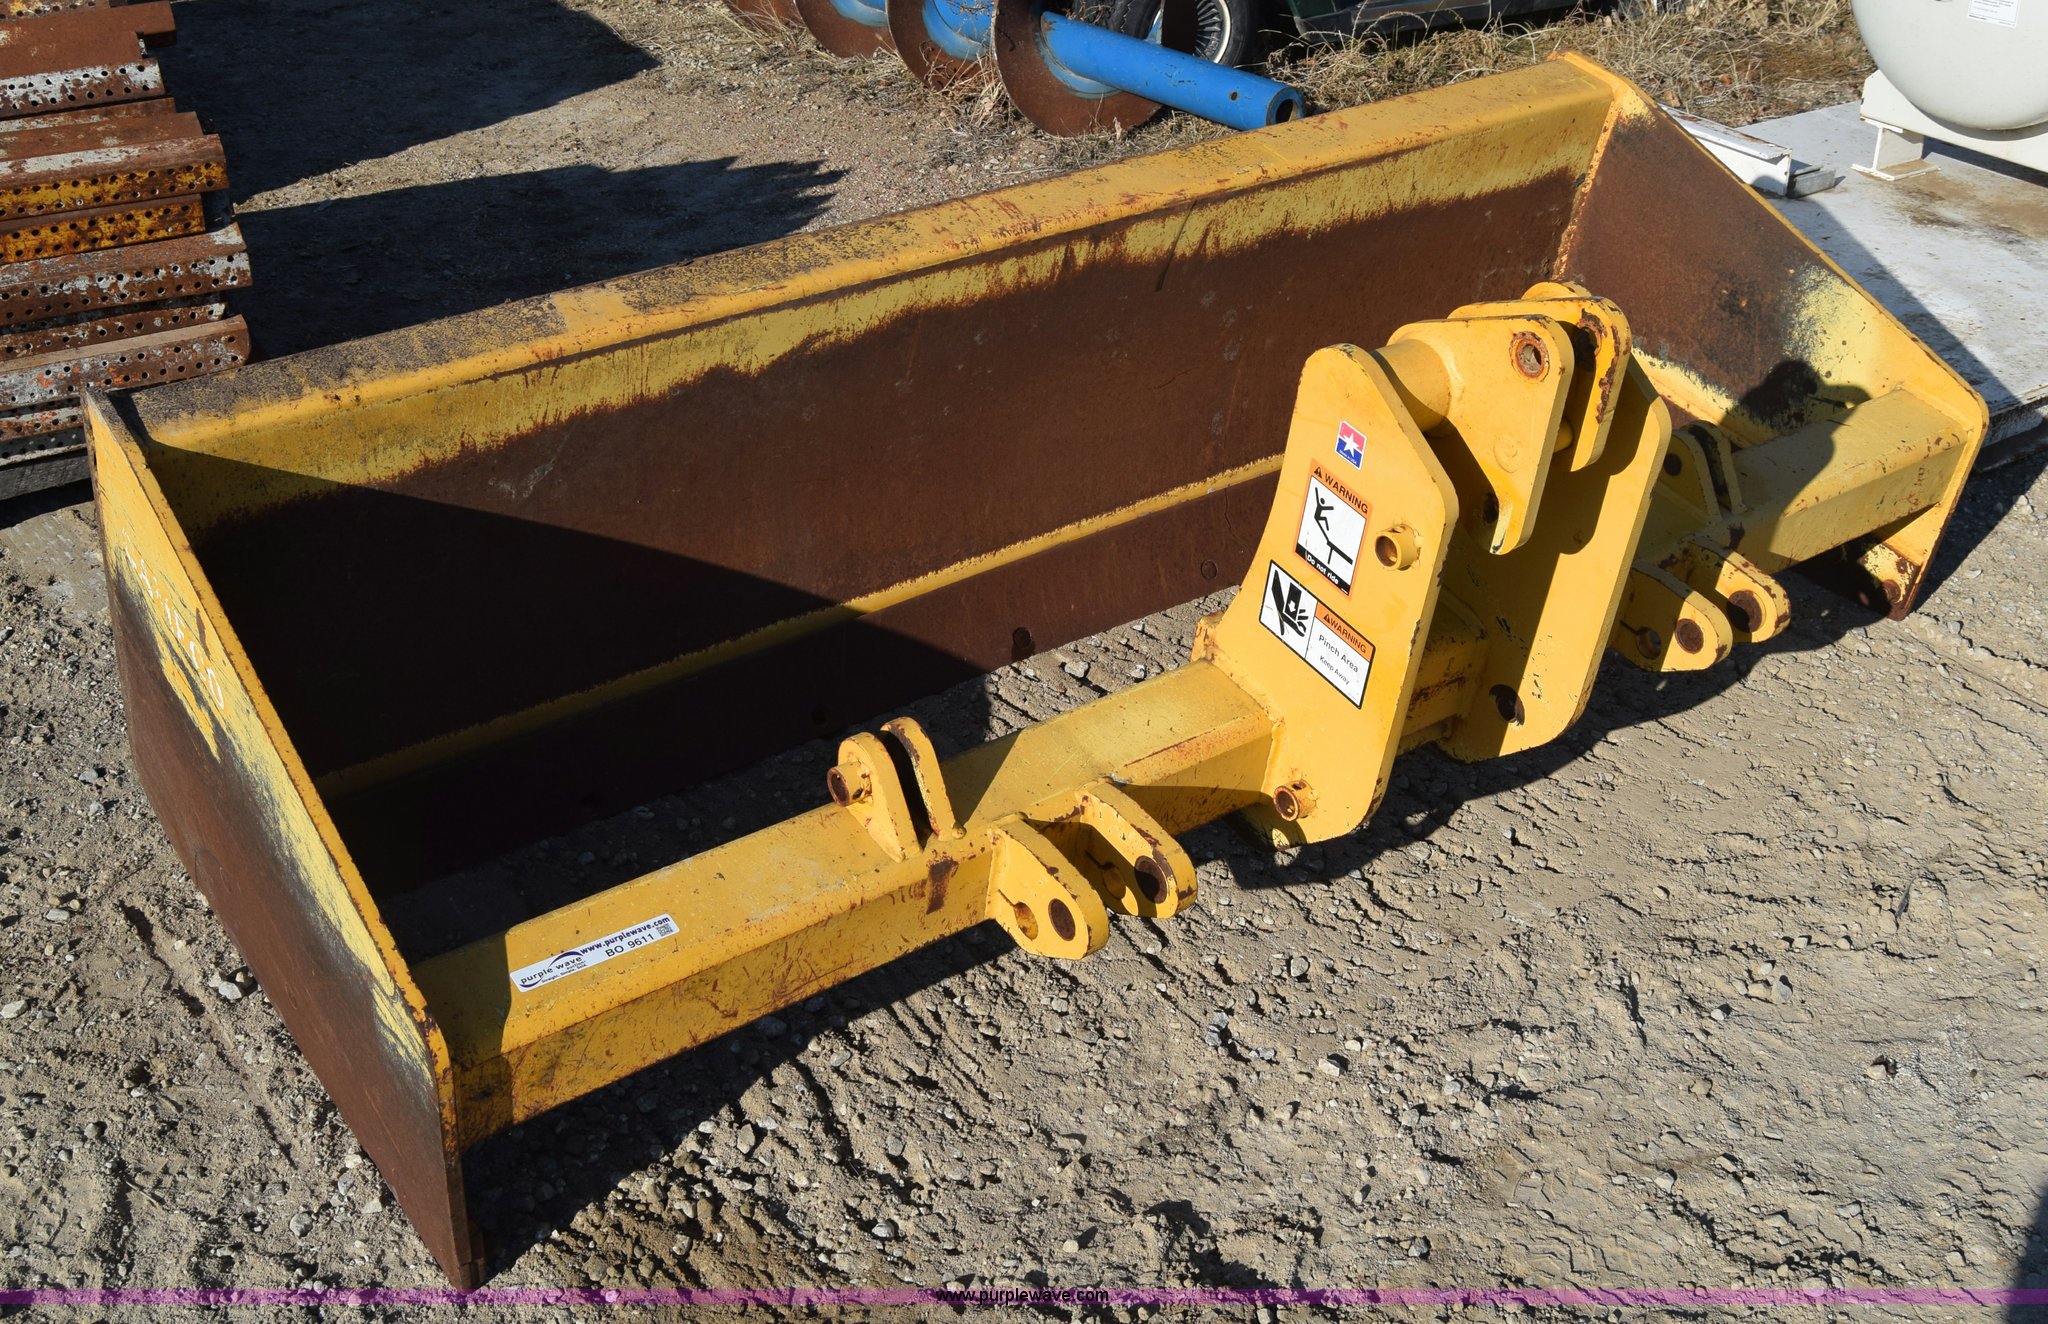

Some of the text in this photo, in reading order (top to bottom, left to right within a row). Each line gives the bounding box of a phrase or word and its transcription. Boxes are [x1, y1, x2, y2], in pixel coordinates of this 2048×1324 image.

[1325, 472, 1368, 515] WARNING
[1307, 553, 1339, 585] Do not ride
[1330, 617, 1367, 654] WARNING
[1318, 634, 1359, 673] Pinch Area
[1319, 655, 1350, 685] Keep Away
[579, 916, 671, 955] www.purplewave.com
[605, 933, 655, 957] BO 9611
[520, 956, 582, 984] purple wave
